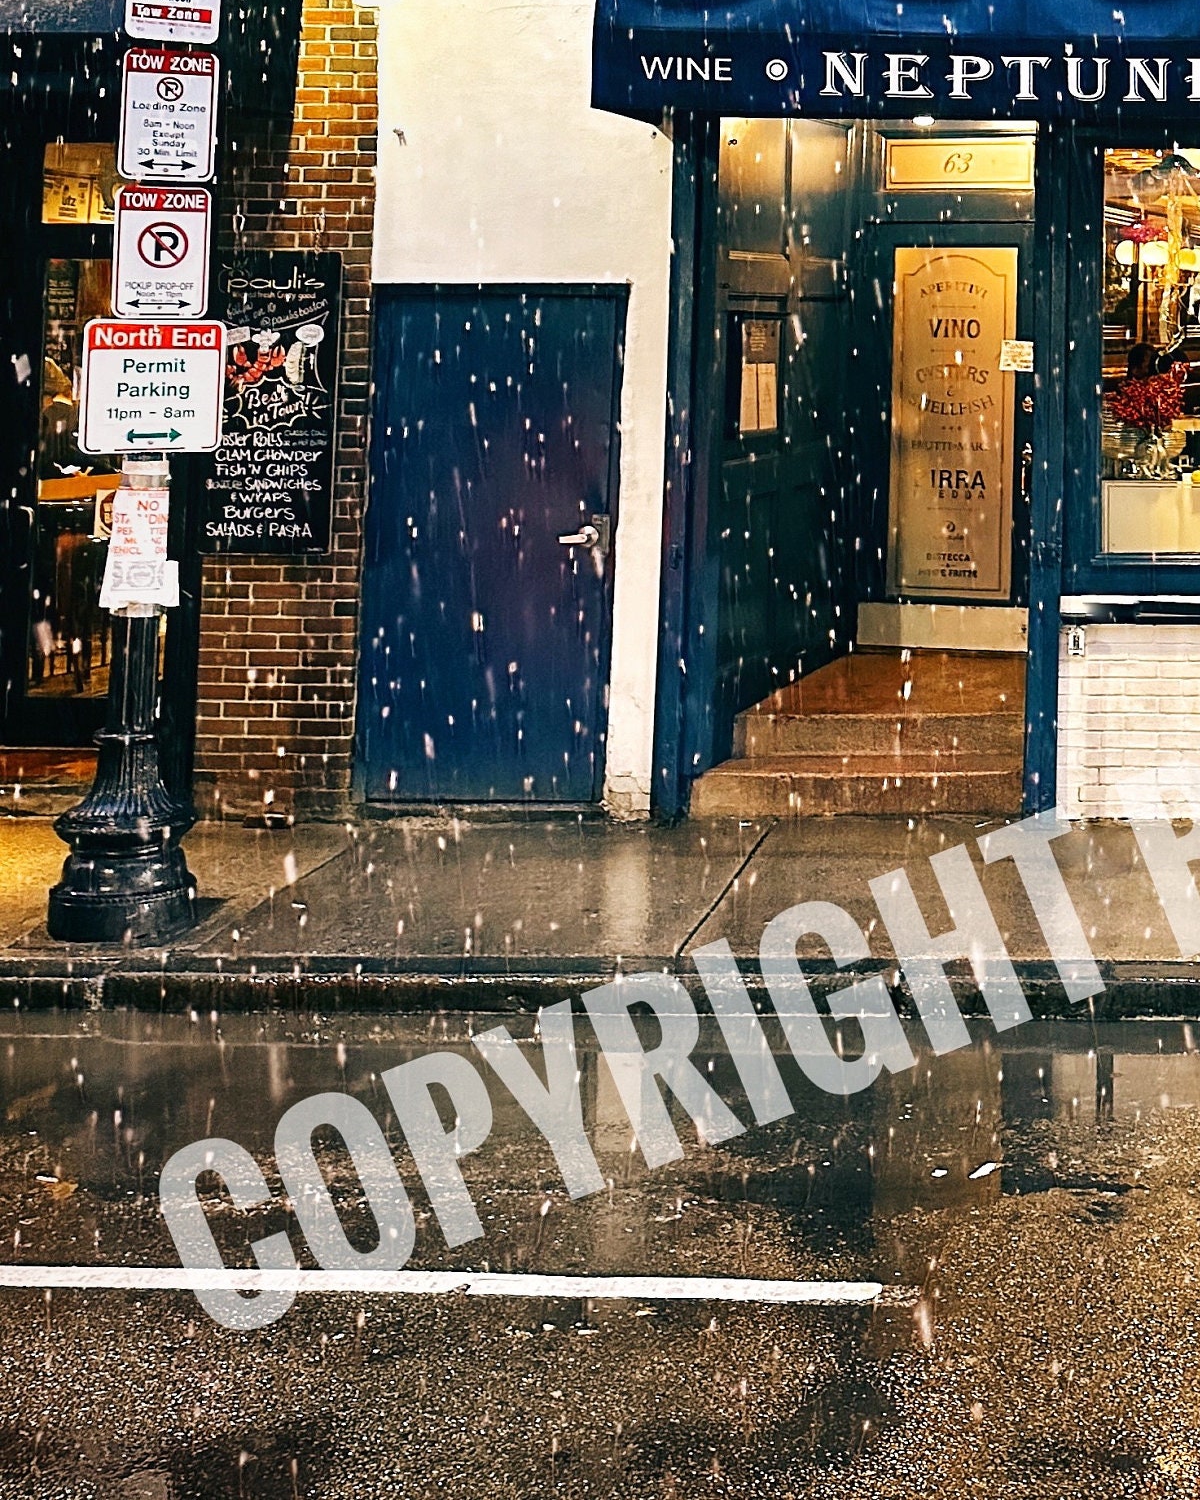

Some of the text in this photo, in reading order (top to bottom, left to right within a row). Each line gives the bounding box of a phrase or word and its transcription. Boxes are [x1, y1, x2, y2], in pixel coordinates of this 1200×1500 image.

[135, 4, 201, 21] Tow Zone
[130, 54, 212, 73] TOW ZONE
[641, 56, 732, 81] WINE
[132, 101, 206, 113] Loading Zone
[143, 119, 162, 128] 8am
[173, 121, 195, 130] Noon
[152, 130, 184, 139] Except
[152, 138, 186, 148] Sunday
[137, 148, 150, 156] 30
[175, 150, 198, 158] Limit
[944, 153, 973, 174] 63
[123, 192, 206, 209] TOW ZONE
[125, 281, 194, 291] PICKUP DROP-OFF
[227, 266, 325, 293] pauli's
[298, 292, 317, 302] good
[920, 281, 988, 299] APERITIVI
[929, 318, 981, 339] VINO
[94, 327, 162, 347] North
[172, 328, 217, 347] End
[123, 358, 186, 373] Permit
[117, 382, 190, 400] Parking
[244, 384, 290, 410] Best
[106, 407, 142, 421] 11pm
[163, 407, 195, 419] 8am
[252, 411, 269, 426] in
[215, 448, 251, 462] CLAM
[214, 463, 246, 477] Fish
[137, 500, 160, 511] NO
[205, 521, 255, 538] SALADS
[269, 522, 313, 538] PASTA
